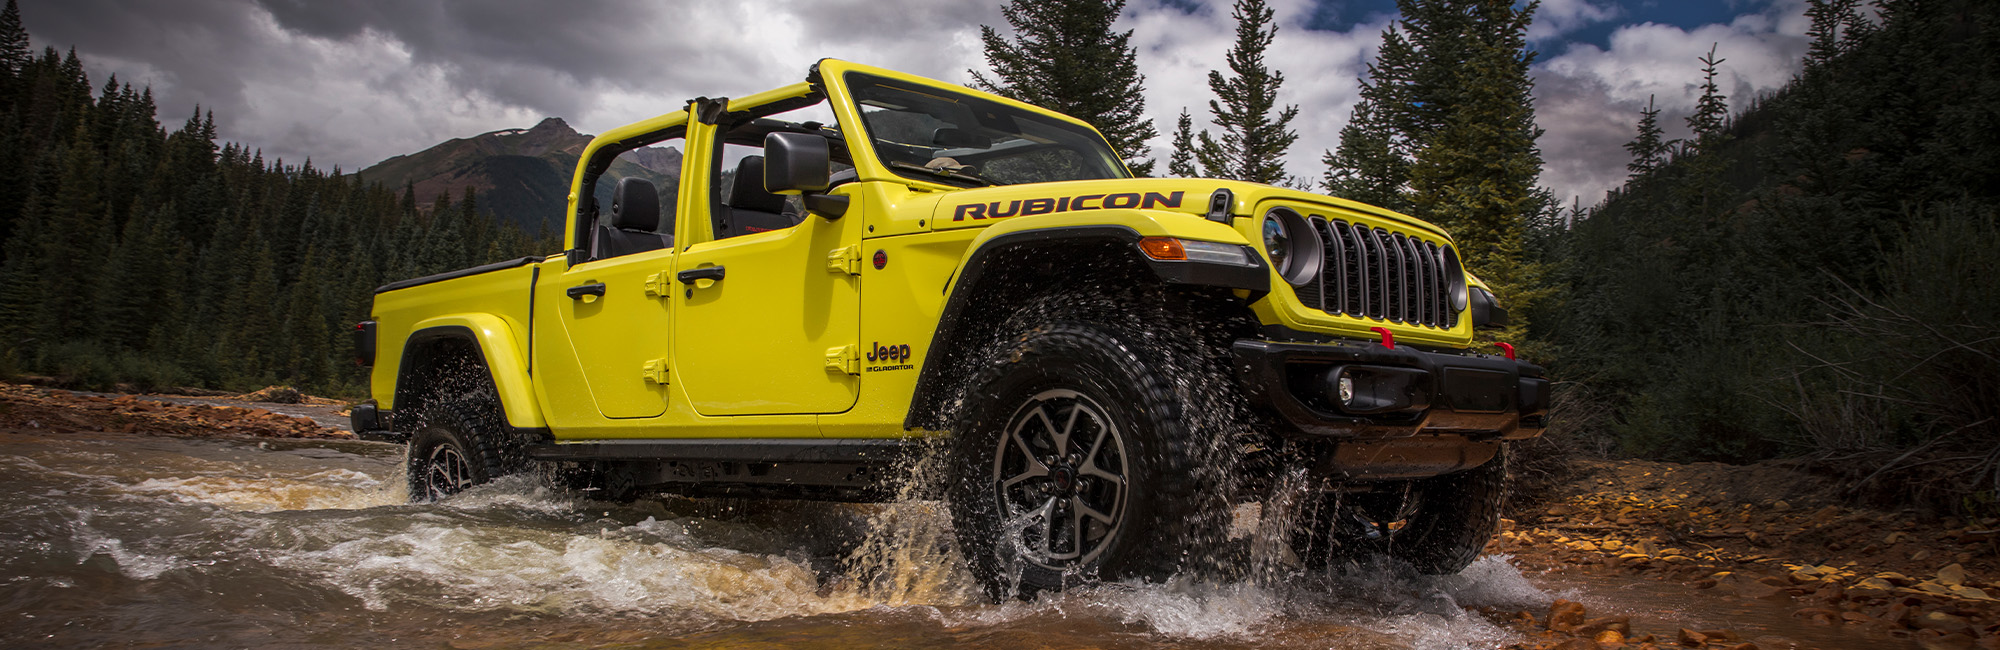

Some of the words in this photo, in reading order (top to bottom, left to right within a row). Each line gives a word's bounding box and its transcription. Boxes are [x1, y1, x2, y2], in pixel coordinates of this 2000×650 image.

[953, 191, 1185, 222] RUBICON
[867, 341, 910, 364] Jeep
[873, 364, 914, 372] GLADIATOR
